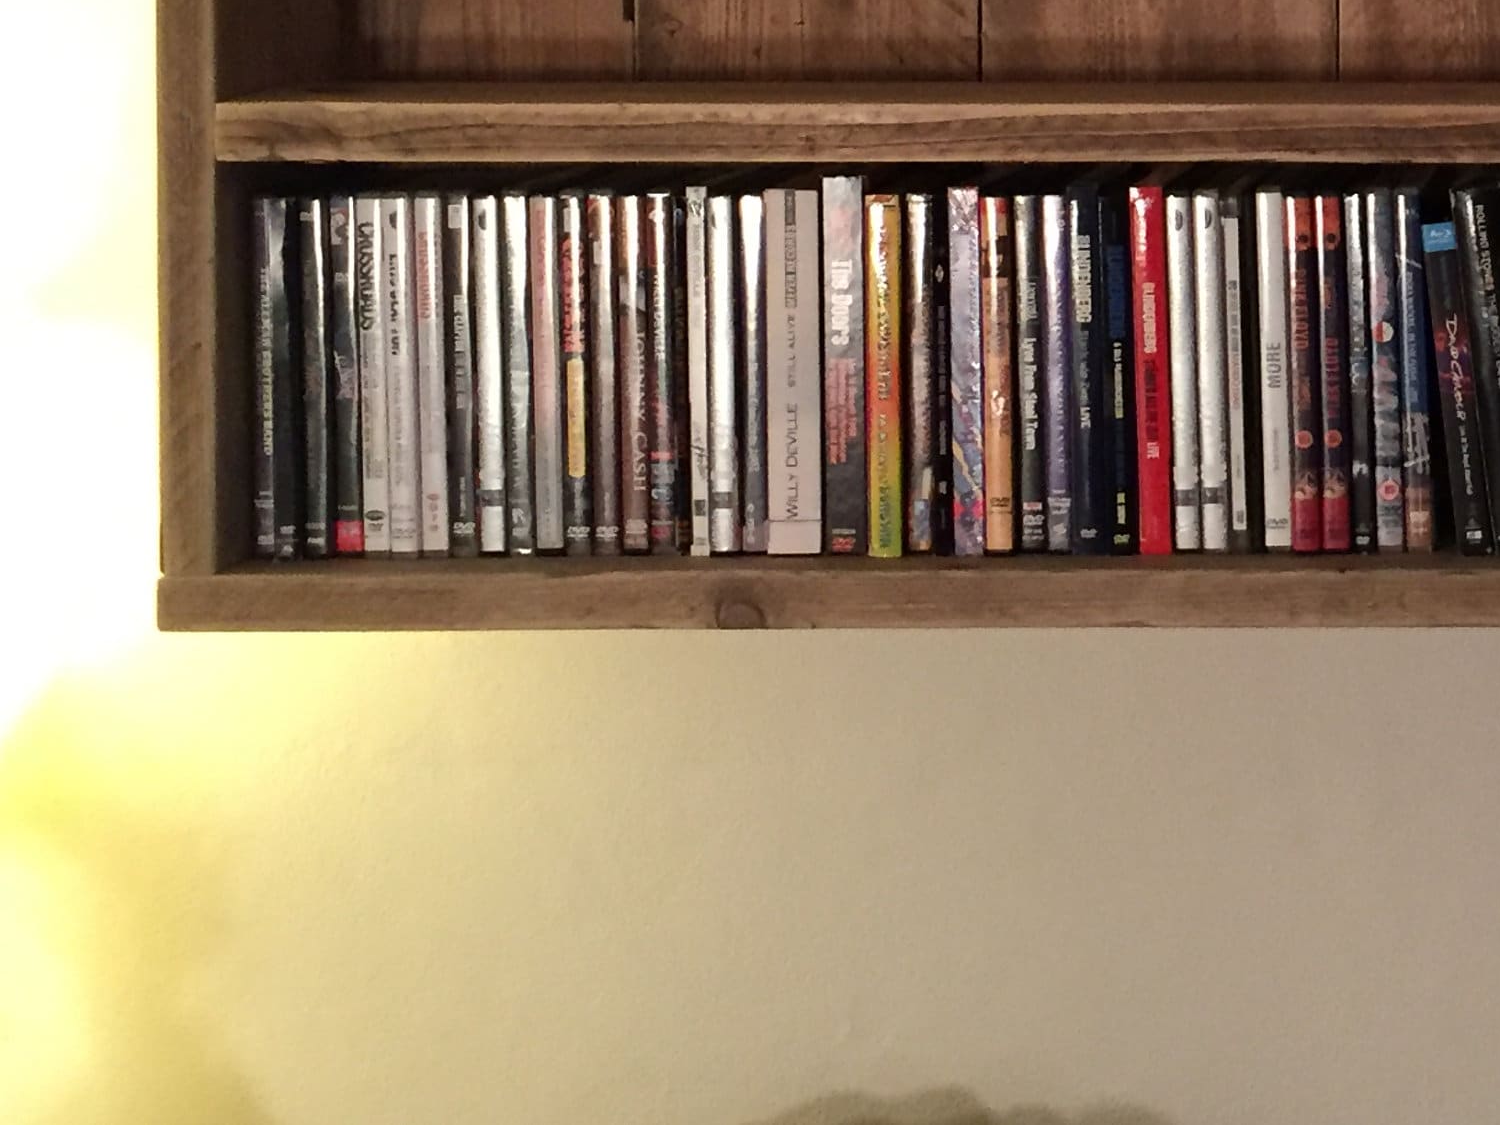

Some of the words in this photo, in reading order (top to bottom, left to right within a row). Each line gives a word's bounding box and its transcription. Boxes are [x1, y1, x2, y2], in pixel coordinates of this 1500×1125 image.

[1474, 203, 1490, 249] ROLLING
[358, 221, 376, 331] CROSSROADS
[830, 259, 854, 290] The
[1479, 249, 1496, 292] STONES
[830, 293, 854, 347] Doors
[1487, 293, 1498, 314] THE
[1295, 305, 1310, 349] FLOYD
[633, 330, 647, 421] JOHNNY
[1023, 364, 1038, 391] From
[1266, 341, 1281, 389] MORE
[263, 420, 274, 455] BAND
[1025, 421, 1040, 451] Town
[1080, 406, 1092, 429] LIVE
[633, 431, 648, 492] CASH
[1146, 442, 1160, 459] LIVE
